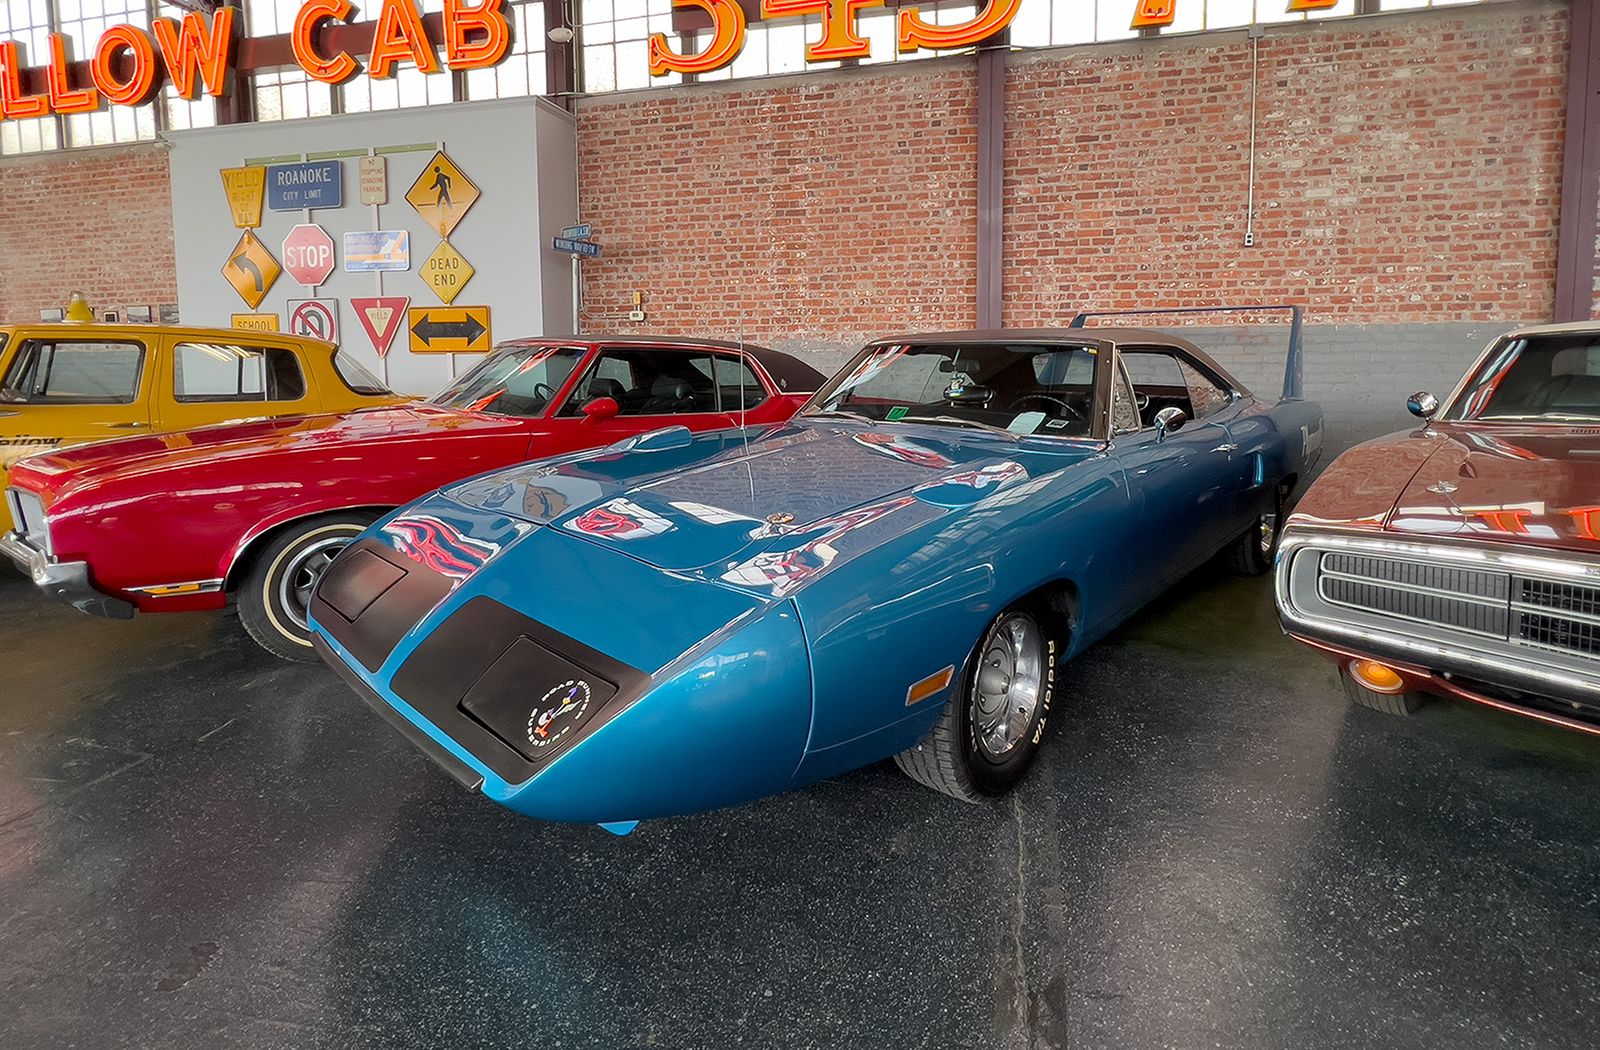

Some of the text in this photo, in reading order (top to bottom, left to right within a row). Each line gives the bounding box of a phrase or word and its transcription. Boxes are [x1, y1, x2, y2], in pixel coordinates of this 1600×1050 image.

[0, 0, 509, 122] LLOW CAB
[277, 167, 332, 186] ROANOKE
[282, 189, 322, 201] CITY LIMIT
[287, 245, 330, 269] STOP
[430, 258, 459, 270] DEAD
[433, 274, 457, 286] END
[370, 312, 388, 321] YIELD
[238, 320, 273, 331] SCHOOL
[1031, 716, 1048, 745] T/A
